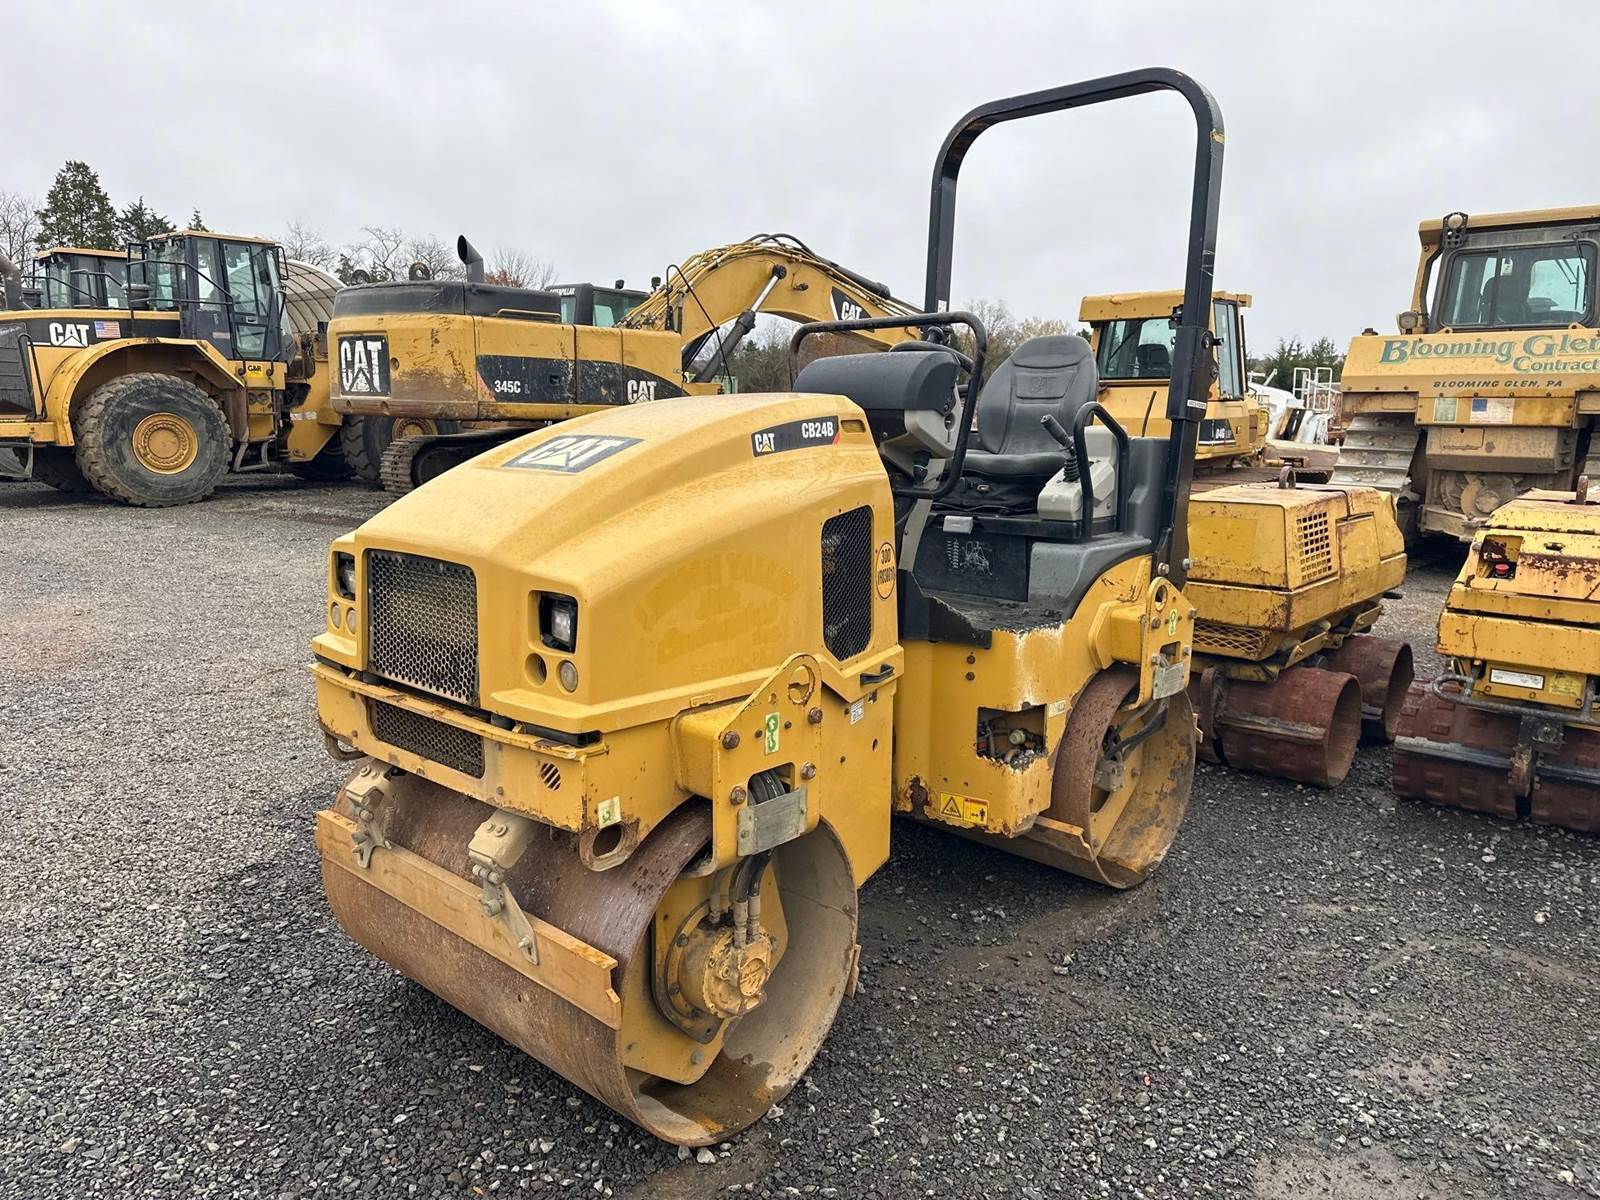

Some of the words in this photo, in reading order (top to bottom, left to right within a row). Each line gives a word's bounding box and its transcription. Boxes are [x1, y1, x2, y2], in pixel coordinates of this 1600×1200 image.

[841, 301, 863, 321] CAT
[49, 322, 90, 348] CAT
[1379, 339, 1516, 365] Blooming
[340, 340, 382, 393] CAT
[494, 379, 521, 394] 345C
[627, 379, 657, 404] CAT
[1433, 380, 1500, 389] BLOOMING
[1503, 380, 1540, 389] GLEN,
[1546, 380, 1563, 388] PA
[754, 432, 776, 453] CAT
[801, 421, 834, 438] CB24B
[512, 437, 627, 468] CAT
